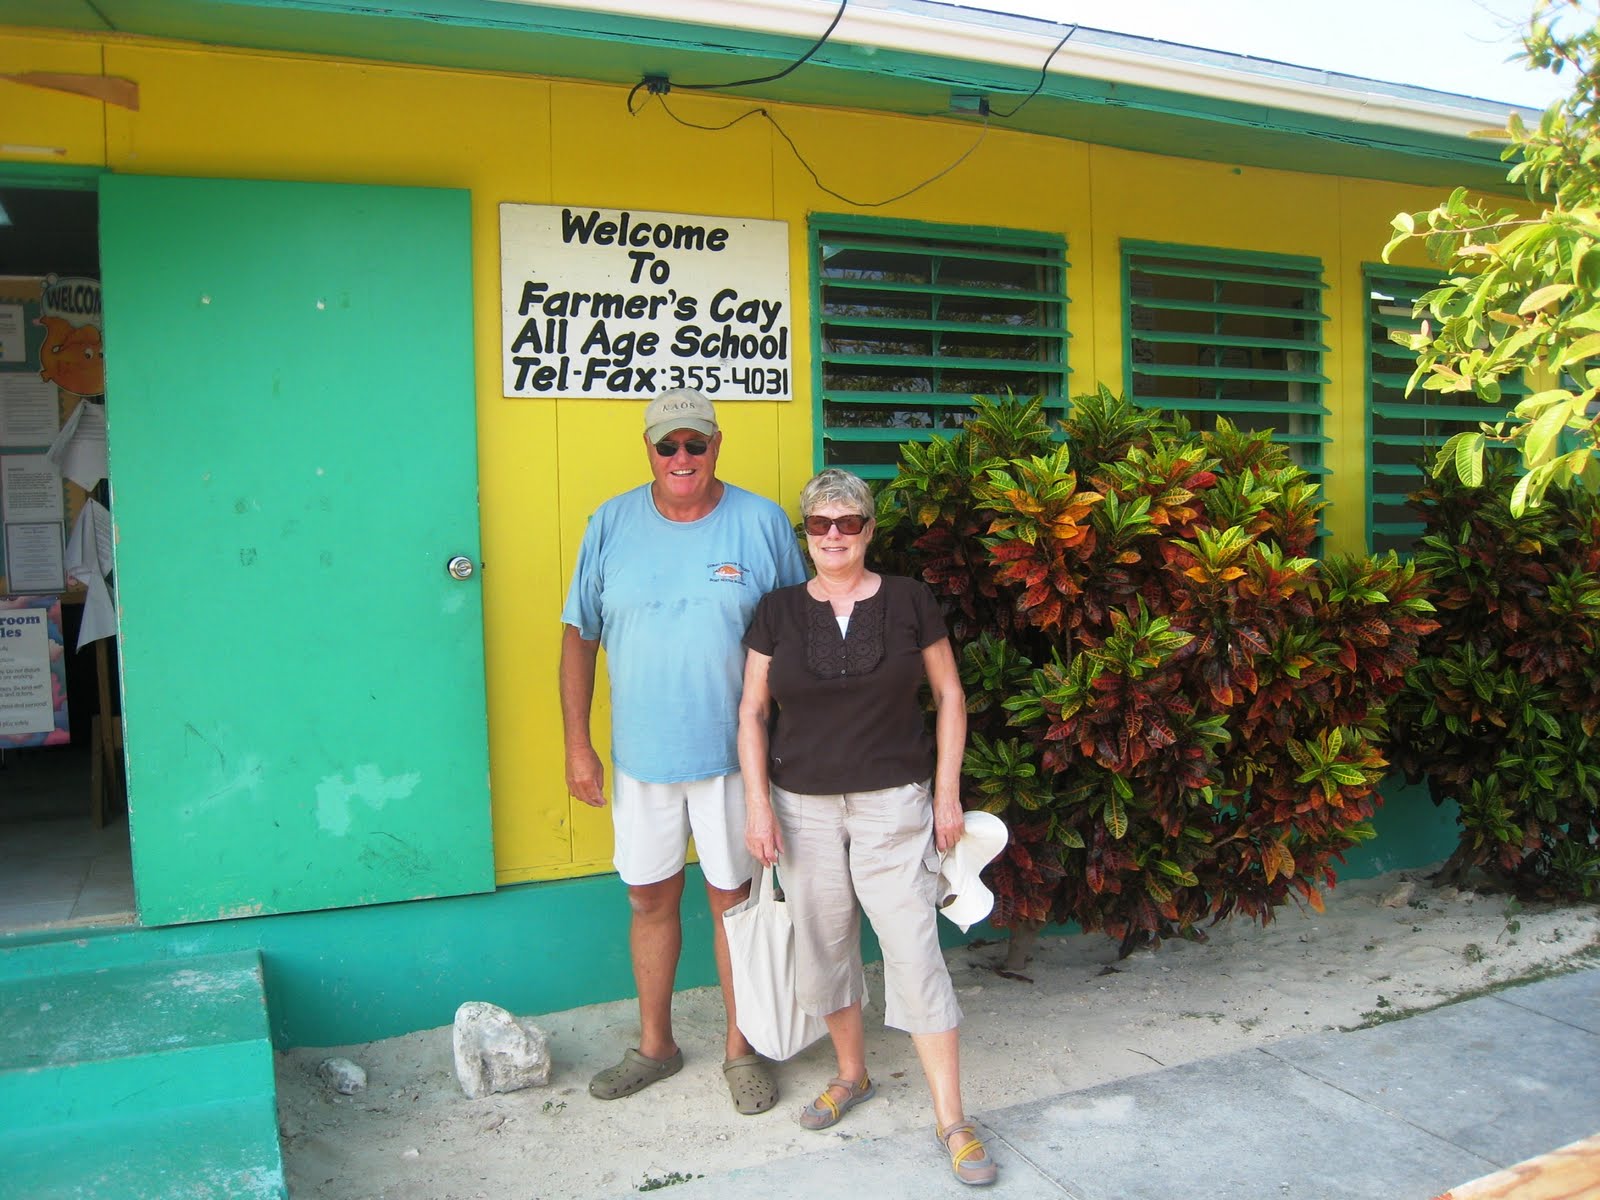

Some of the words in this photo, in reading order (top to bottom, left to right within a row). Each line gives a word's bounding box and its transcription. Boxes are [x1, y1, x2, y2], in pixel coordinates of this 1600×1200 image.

[561, 208, 729, 252] Welcome
[627, 250, 671, 285] To
[518, 280, 698, 322] Farmer's
[709, 288, 782, 334] Cay
[510, 317, 569, 355] All
[580, 319, 660, 368] Age
[670, 324, 789, 361] School
